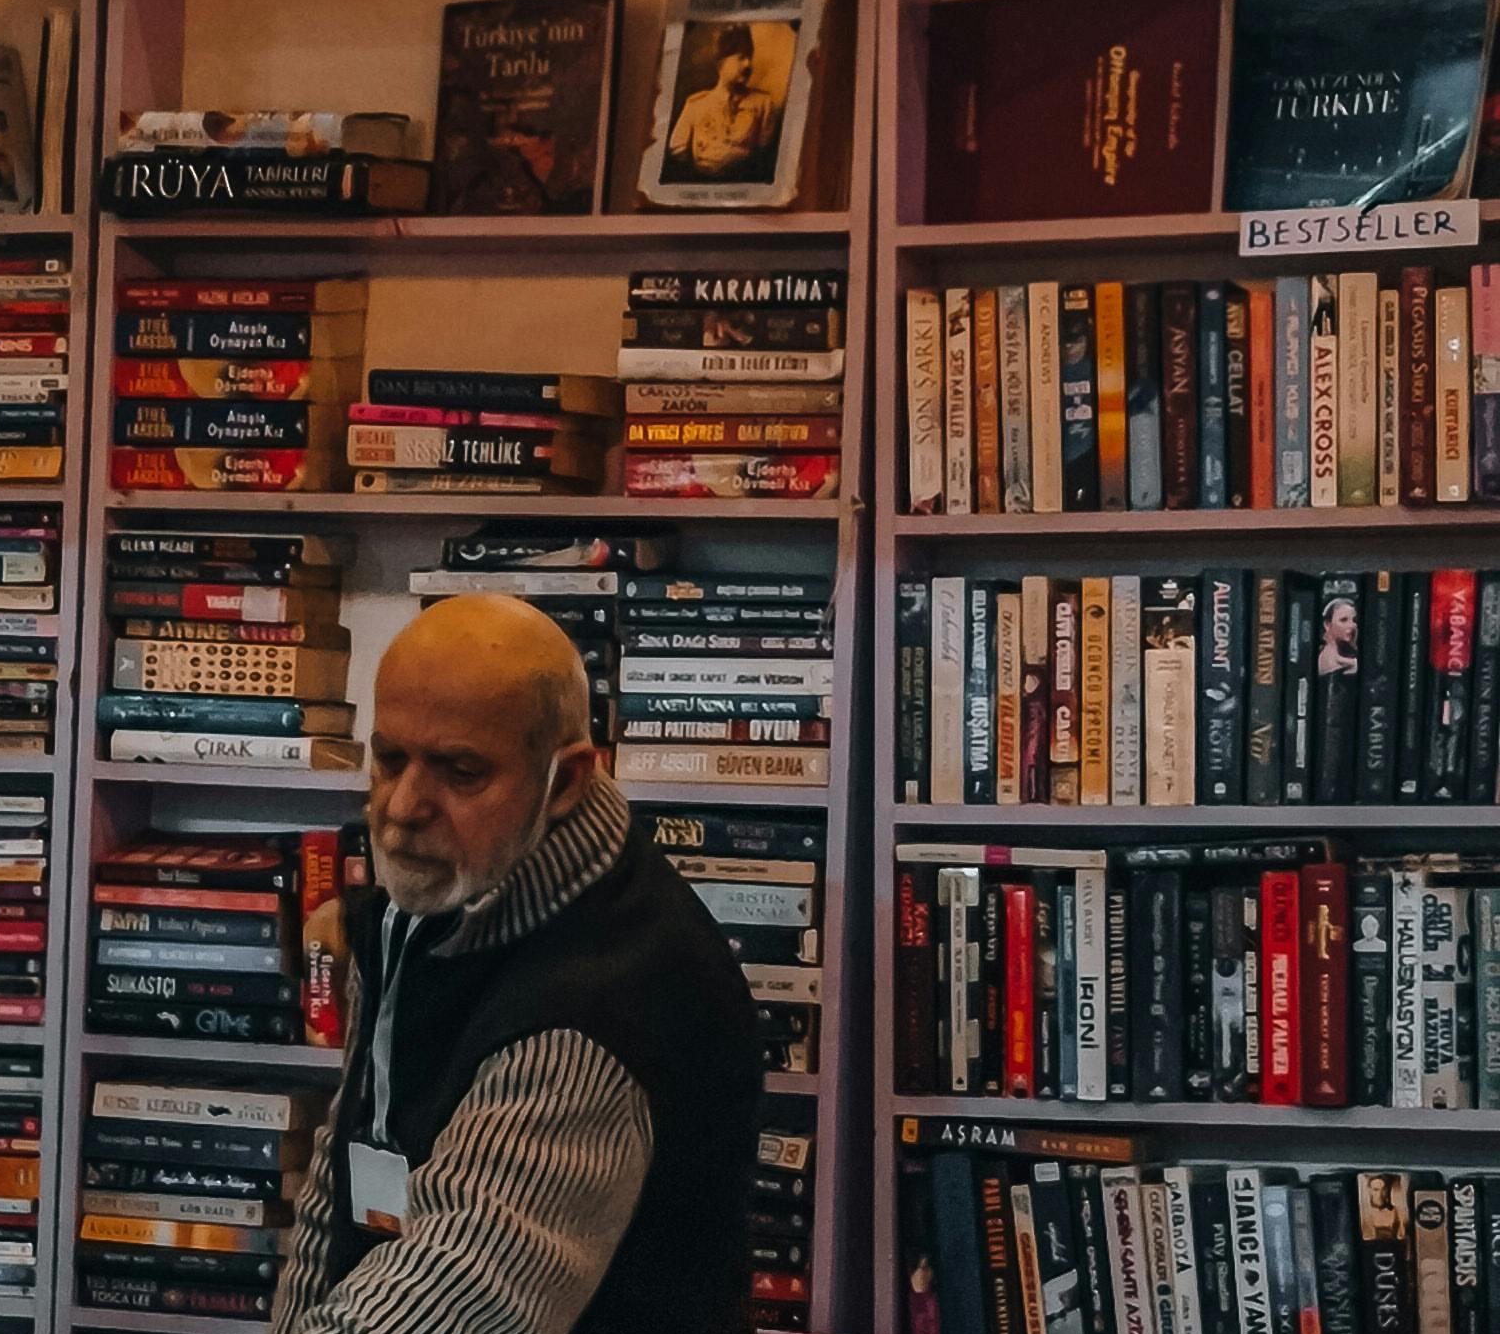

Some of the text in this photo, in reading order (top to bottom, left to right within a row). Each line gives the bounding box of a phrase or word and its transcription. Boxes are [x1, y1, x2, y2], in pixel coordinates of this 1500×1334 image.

[131, 158, 235, 200] RÜYA
[1248, 210, 1457, 249] BESTSELLER
[694, 275, 822, 302] KARANTİNA
[1228, 349, 1244, 417] CELLAT
[1314, 345, 1333, 479] ALEX CROSS
[914, 398, 936, 446] SON
[1211, 581, 1232, 672] ALLEGIANT
[1446, 589, 1467, 678] YABANCI
[194, 737, 253, 759] ÇIRAK
[968, 697, 989, 772] KUŞATMA
[1079, 975, 1099, 1050] İRONİ
[941, 1123, 1016, 1147] AŞRAM
